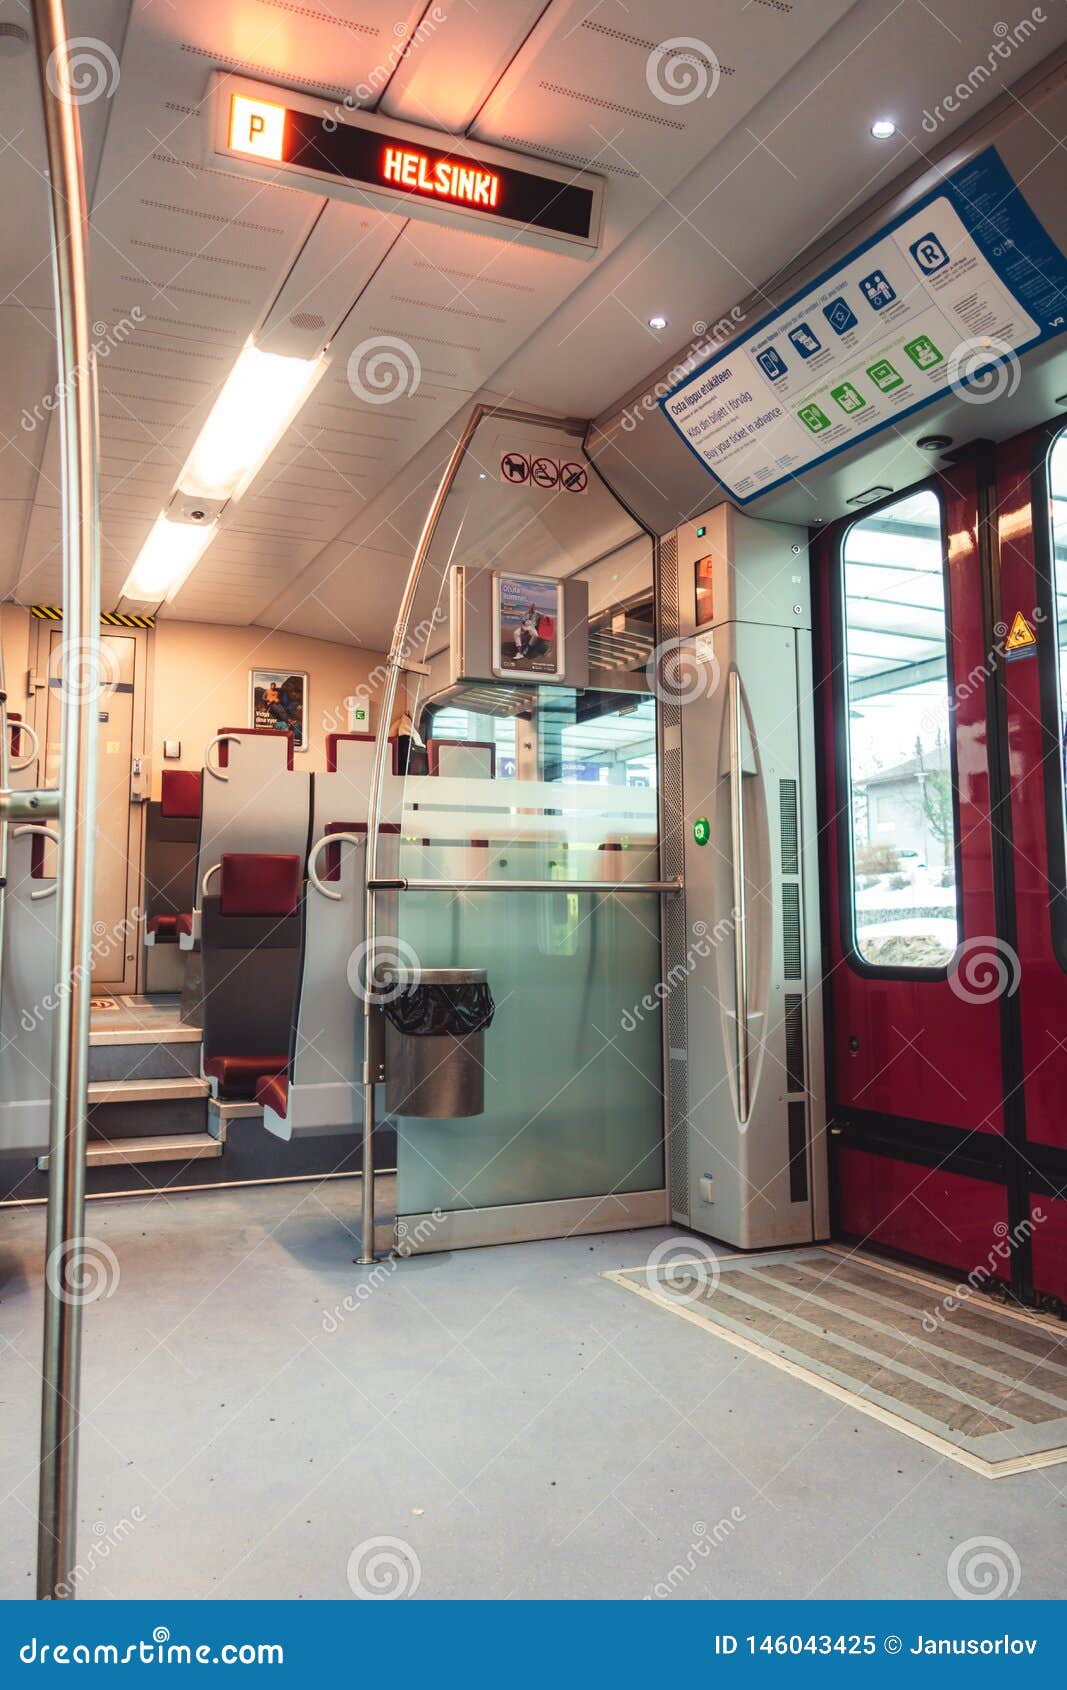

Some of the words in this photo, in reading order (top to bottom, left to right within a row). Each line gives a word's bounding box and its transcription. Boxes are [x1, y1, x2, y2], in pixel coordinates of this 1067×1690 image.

[249, 114, 265, 143] P
[384, 148, 498, 206] HELSINKI
[671, 400, 687, 415] Osta
[703, 445, 718, 460] Buy
